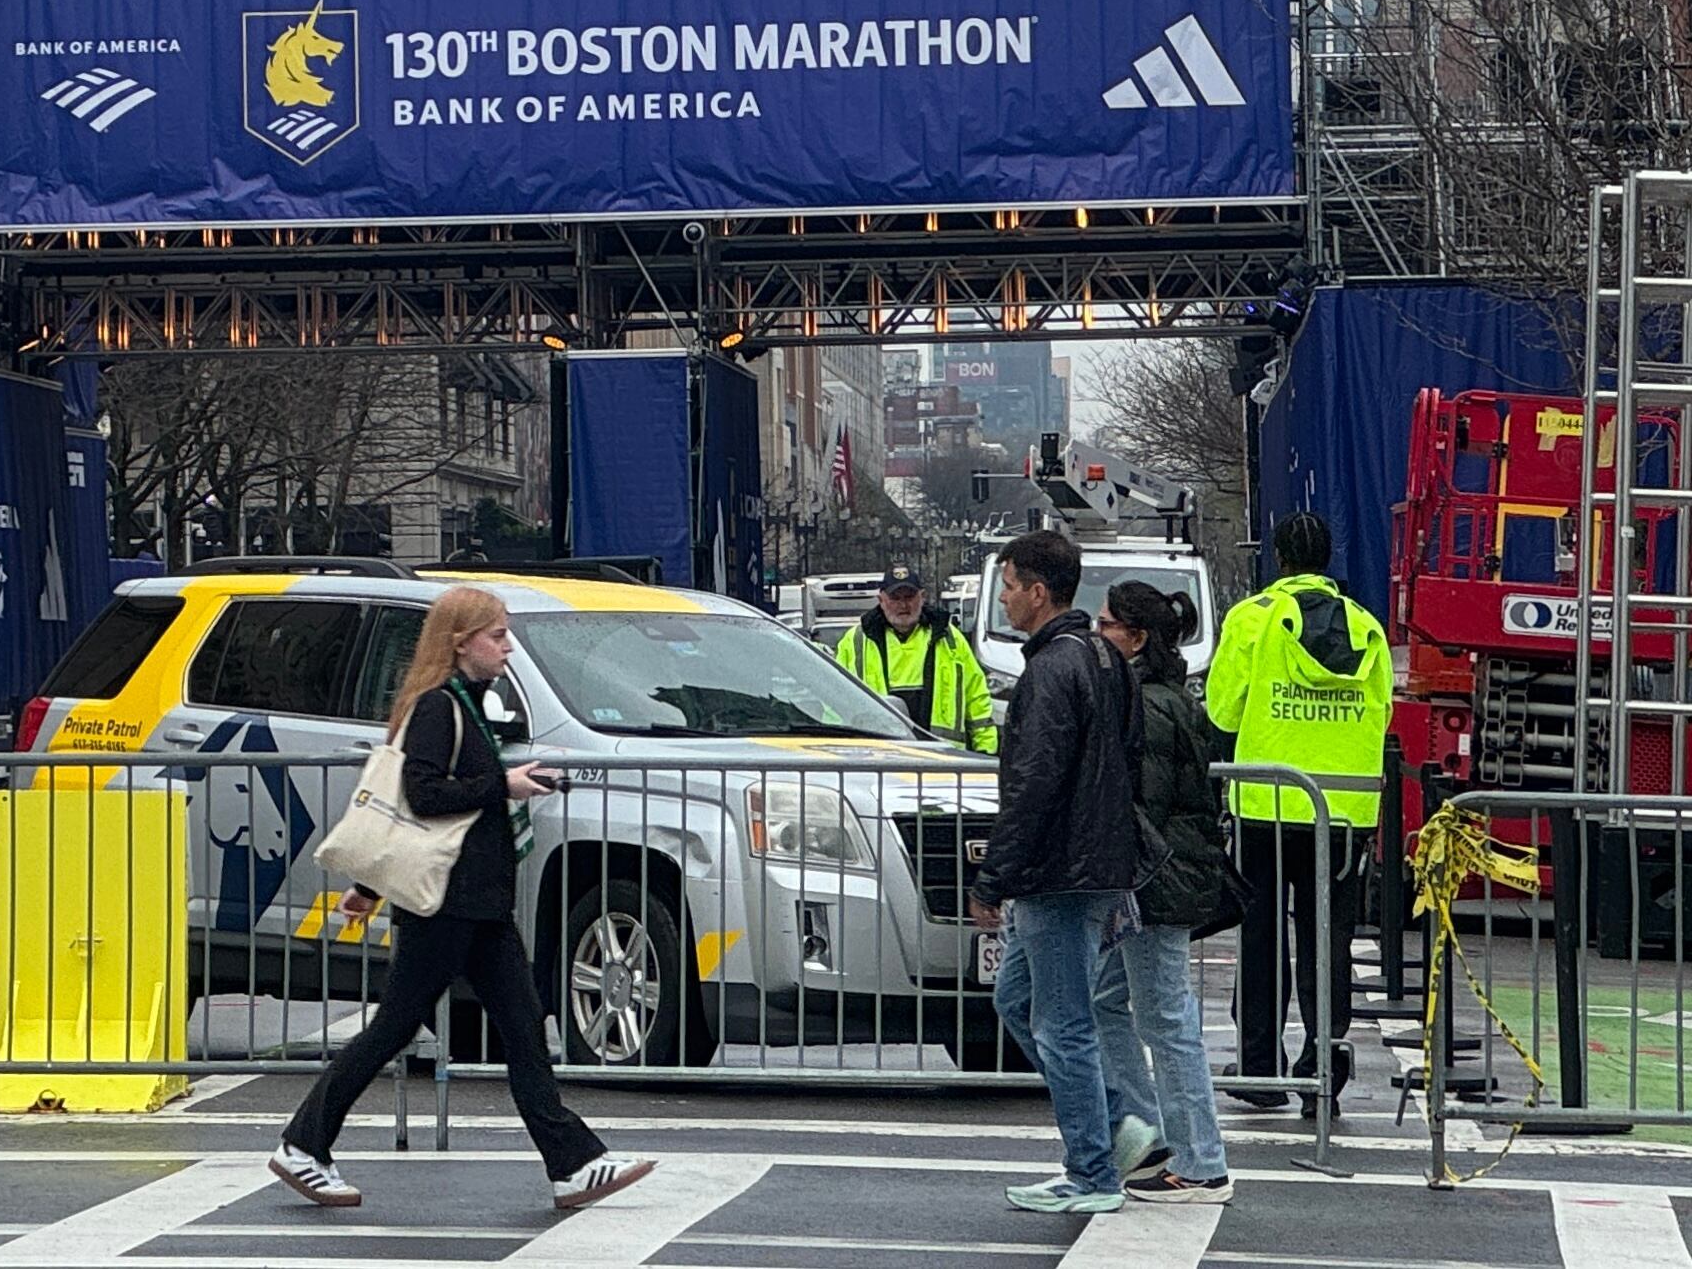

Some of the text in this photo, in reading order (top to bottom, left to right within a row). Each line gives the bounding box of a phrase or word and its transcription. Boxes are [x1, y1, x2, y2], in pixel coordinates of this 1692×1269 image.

[15, 39, 181, 56] BANK OF AMERICA
[385, 30, 498, 79] 130TH
[507, 25, 717, 76] BOSTON
[394, 91, 761, 126] BANK OF AMERICA
[959, 362, 995, 377] BON
[1556, 603, 1613, 620] Uned
[1272, 682, 1365, 703] PalAmerican
[1271, 702, 1366, 723] SECURITY
[63, 717, 143, 738] Private Patrol
